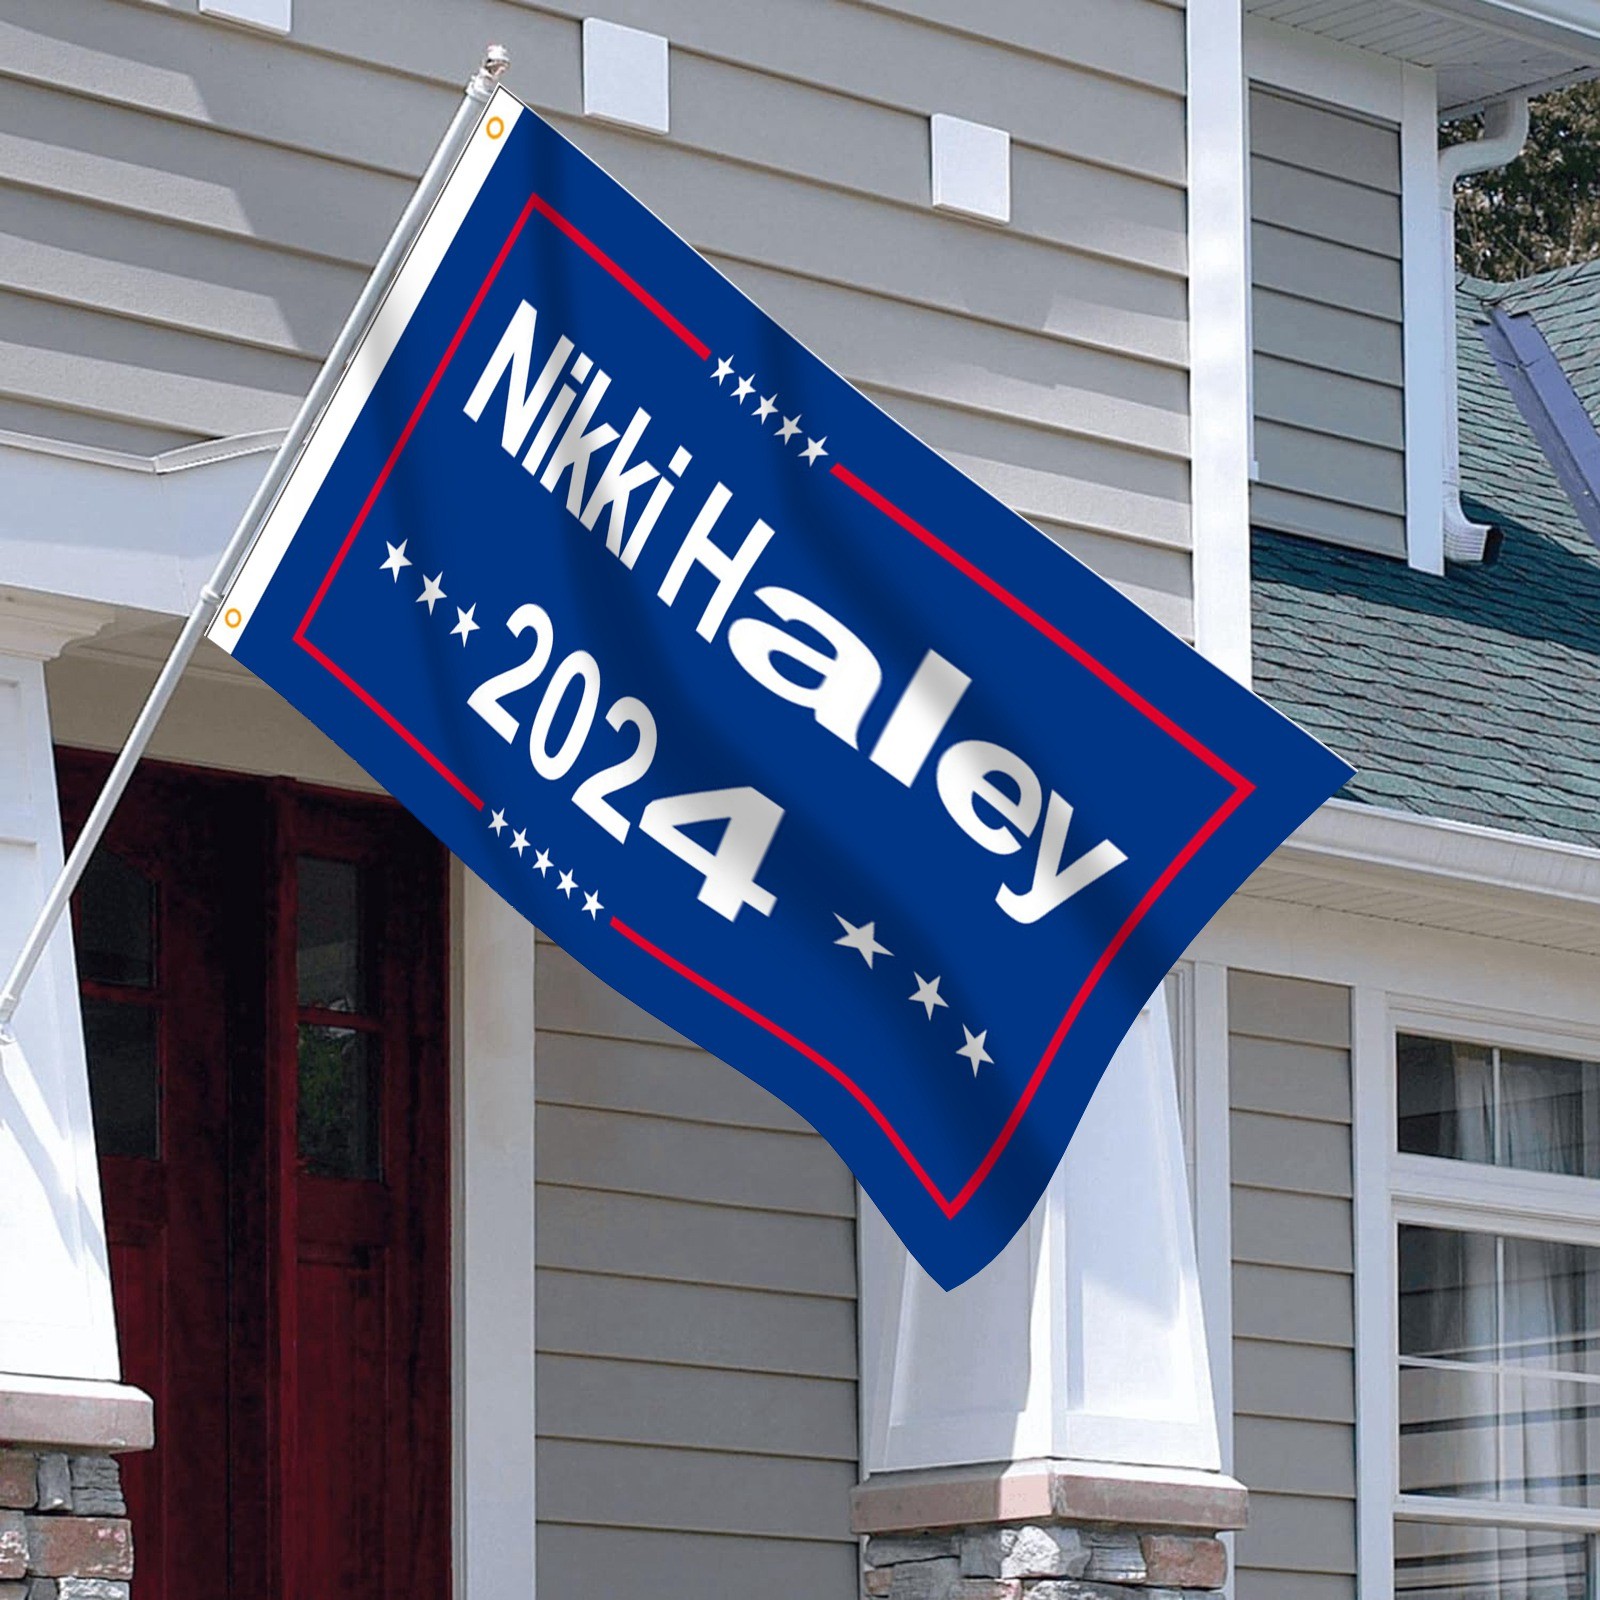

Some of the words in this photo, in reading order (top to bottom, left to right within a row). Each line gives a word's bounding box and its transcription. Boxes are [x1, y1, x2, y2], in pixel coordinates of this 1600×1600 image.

[462, 298, 693, 571] Nikki
[656, 480, 1129, 926] Haley
[466, 602, 786, 923] 2024
